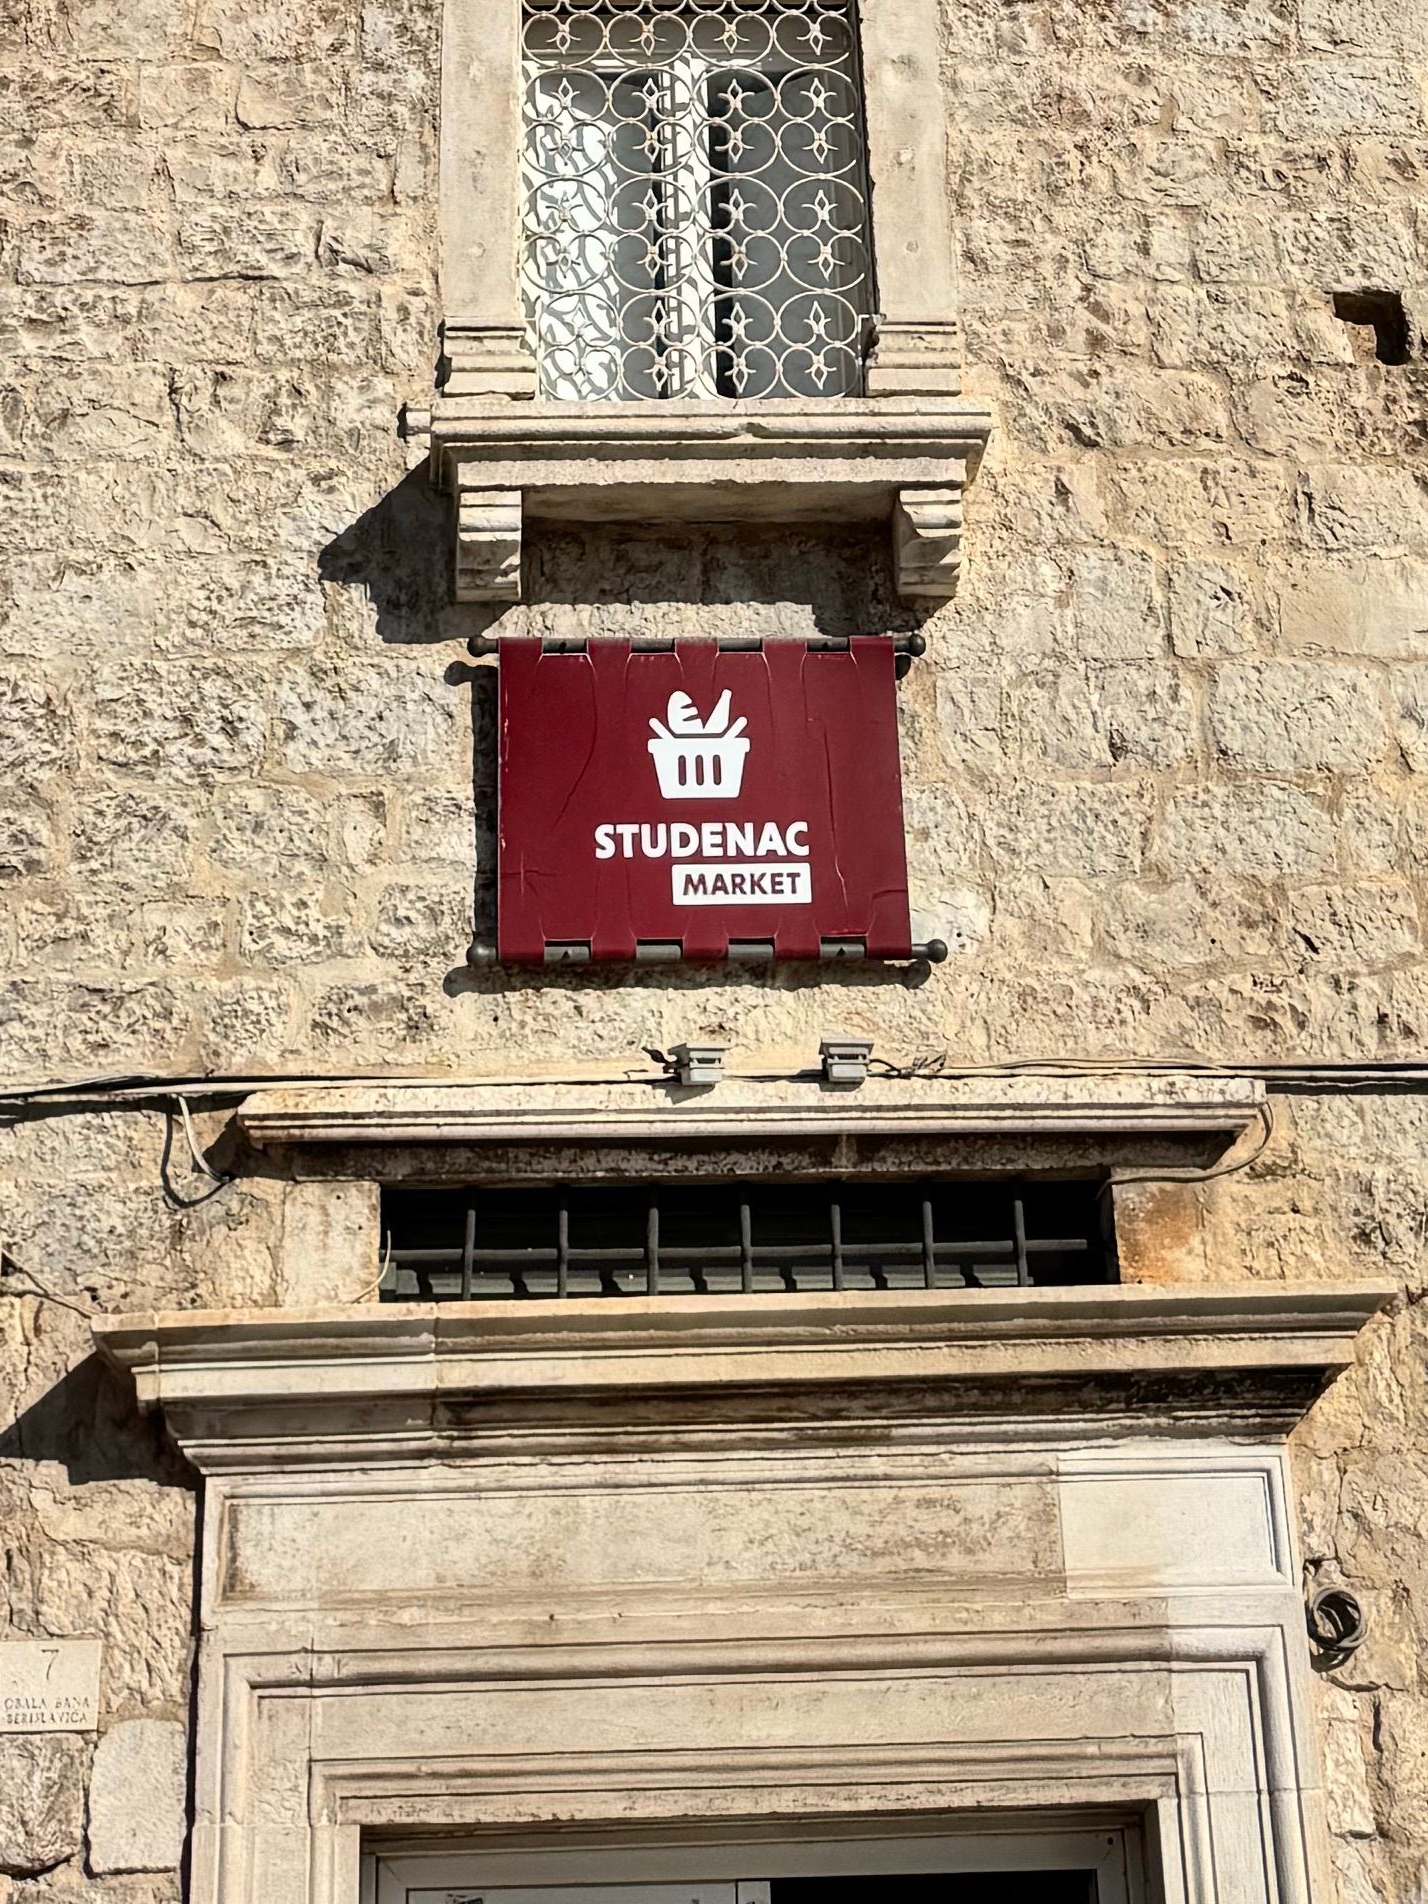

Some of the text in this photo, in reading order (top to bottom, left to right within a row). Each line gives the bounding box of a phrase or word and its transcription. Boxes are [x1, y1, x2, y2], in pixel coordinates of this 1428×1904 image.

[594, 822, 810, 859] STUDENAC
[682, 871, 801, 896] MARKET
[40, 1648, 60, 1682] 7
[4, 1697, 47, 1710] OBALA
